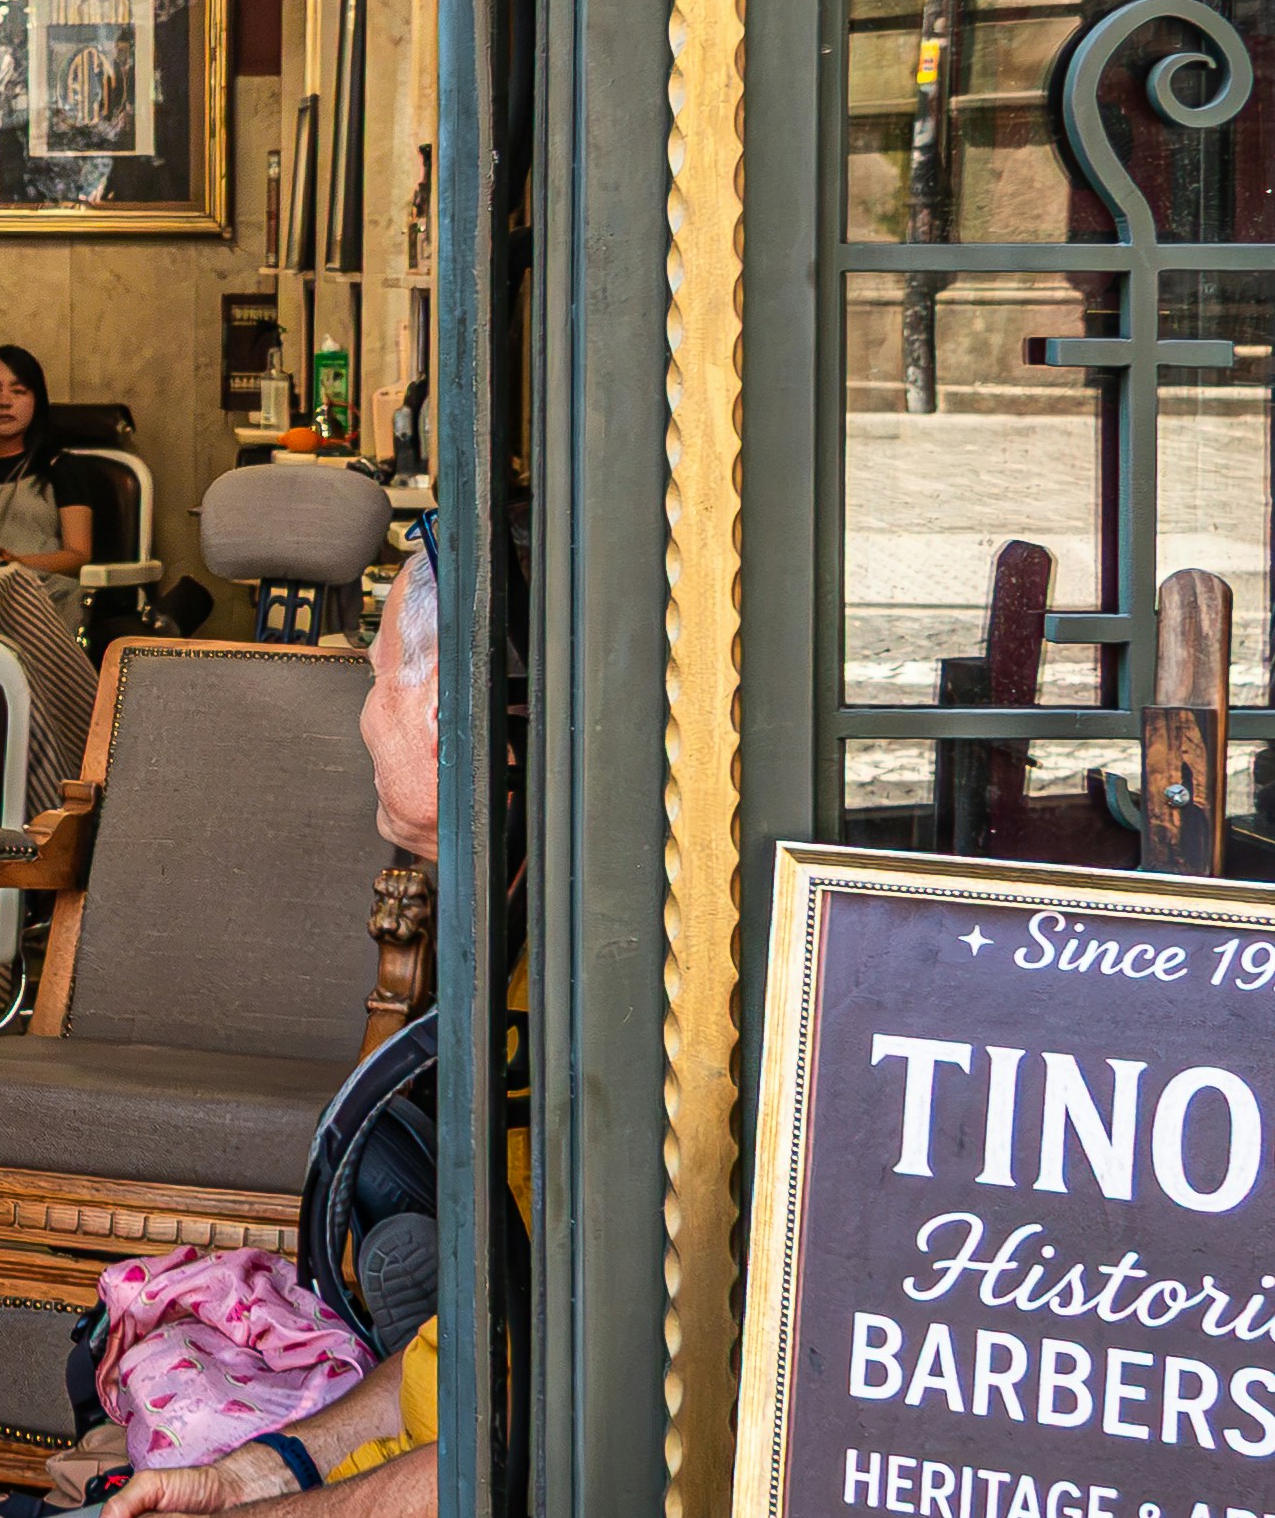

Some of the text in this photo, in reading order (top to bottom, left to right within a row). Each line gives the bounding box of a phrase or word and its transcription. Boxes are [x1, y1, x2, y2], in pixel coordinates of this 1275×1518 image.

[1013, 910, 1275, 991] Since 19
[870, 1032, 1263, 1214] TINO
[902, 1211, 1275, 1342] Histori
[847, 1310, 1275, 1458] BARBERS
